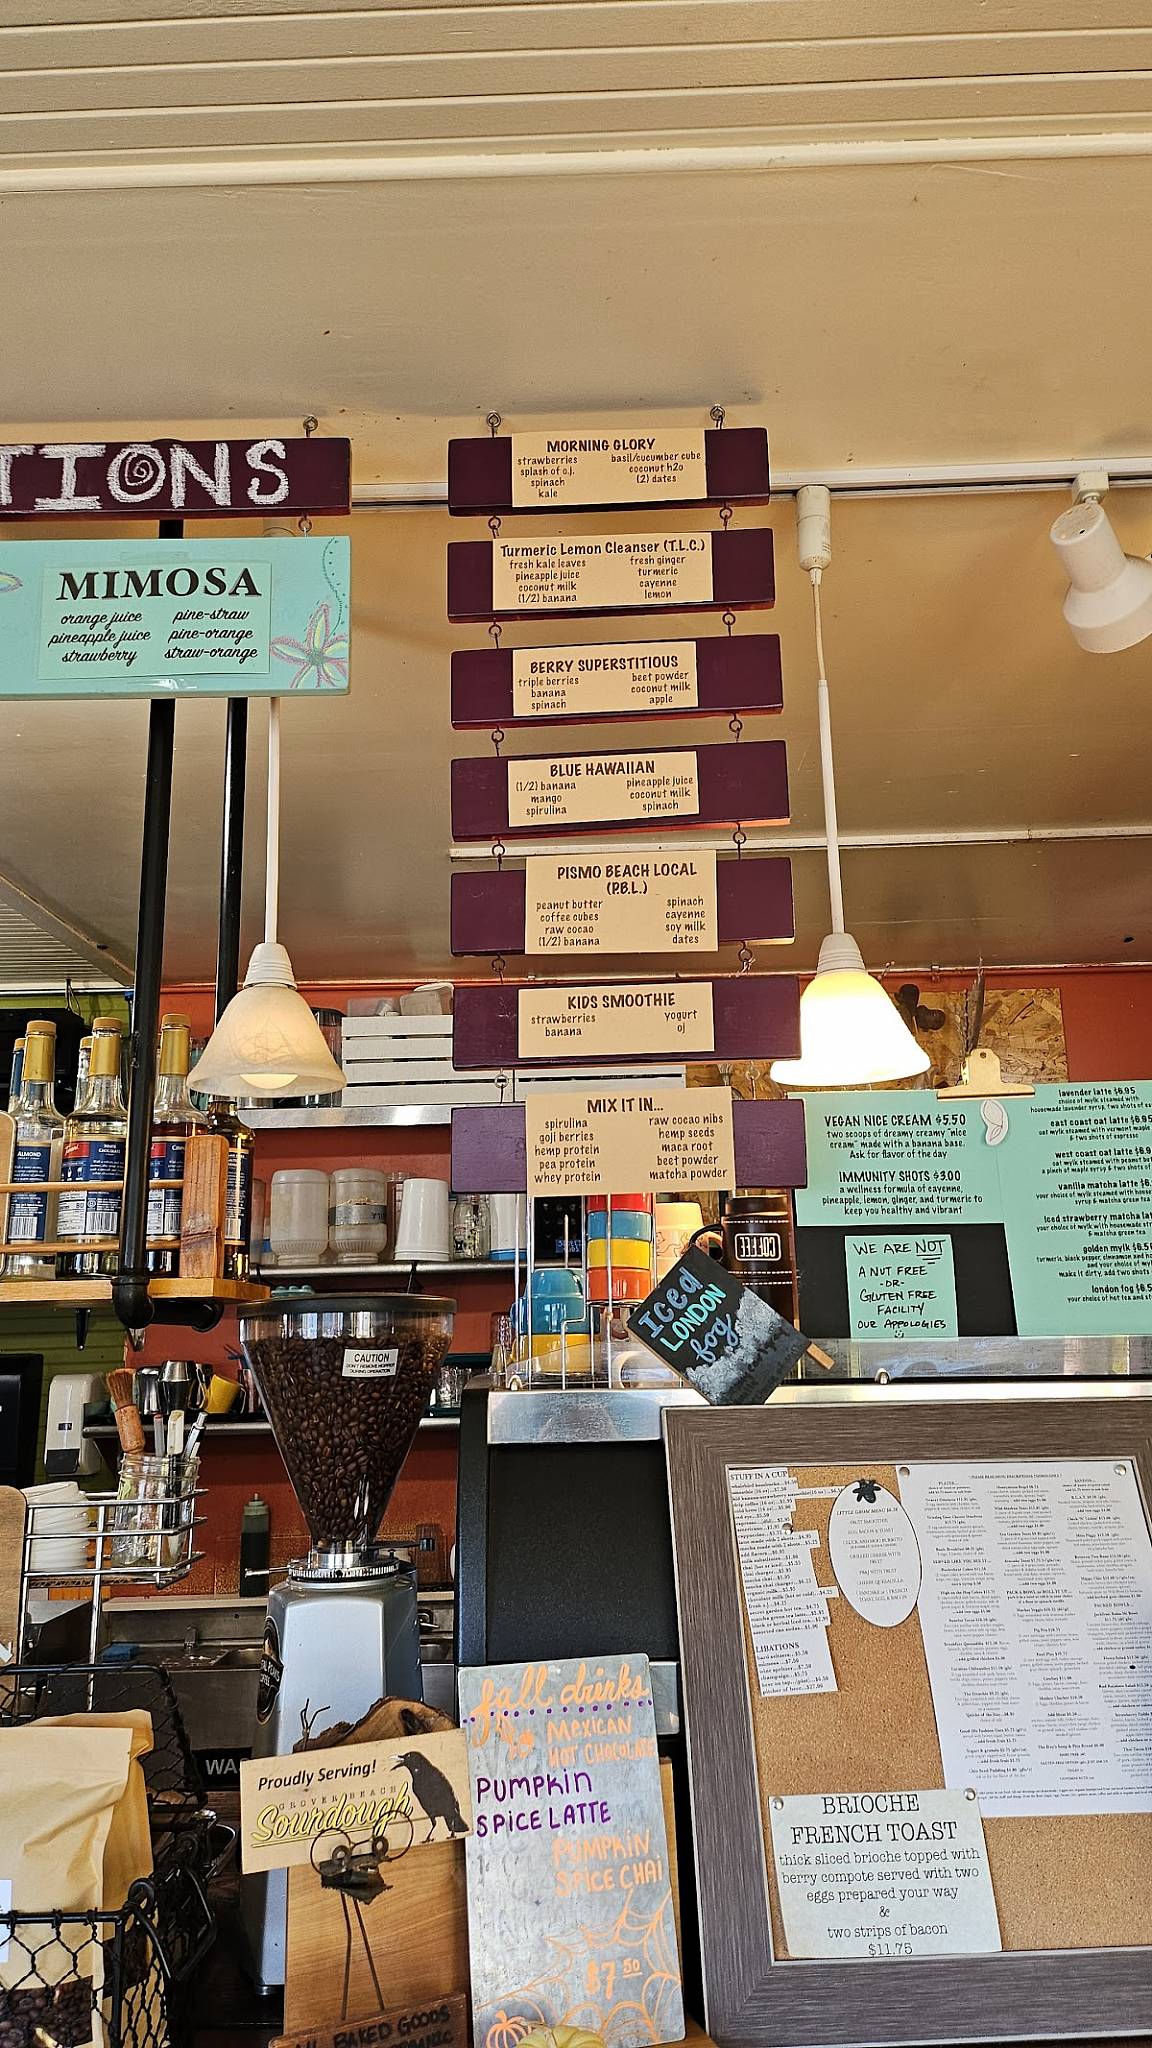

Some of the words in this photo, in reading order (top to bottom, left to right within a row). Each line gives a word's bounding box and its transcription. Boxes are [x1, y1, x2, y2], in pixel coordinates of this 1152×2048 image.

[547, 440, 609, 452] MORNING
[614, 439, 655, 450] GLORY
[518, 455, 577, 465] strawberries
[612, 452, 678, 462] basil/cucumber
[681, 451, 701, 460] cube
[521, 466, 548, 477] splash
[551, 466, 560, 475] of
[563, 466, 574, 476] o.j.
[629, 464, 664, 472] coconut
[667, 463, 683, 471] h2o
[531, 477, 564, 488] spinach
[637, 474, 649, 483] (2)
[539, 488, 557, 498] kale
[501, 545, 557, 557] Turmeric
[561, 543, 601, 555] Lemon
[605, 542, 659, 553] Cleanser
[664, 539, 704, 552] (T.L.C.)
[510, 559, 533, 569] fresh
[537, 559, 555, 568] kale
[558, 559, 585, 568] leaves
[630, 555, 654, 565] fresh
[657, 556, 686, 565] ginger
[56, 568, 262, 600] MIMOSA
[60, 611, 108, 624] orange
[105, 610, 143, 627] juice
[173, 608, 249, 624] pine-straw
[48, 630, 116, 645] pineapple
[112, 629, 151, 644] juice
[168, 629, 253, 645] pine-orange
[62, 648, 137, 667] strawberry
[164, 646, 257, 661] straw-orange
[531, 660, 573, 673] BERRY
[578, 656, 678, 671] SUPERSTITIOUS
[519, 677, 543, 688] triple
[547, 676, 578, 685] berries
[632, 673, 652, 681] beet
[655, 671, 688, 682] powder
[551, 764, 581, 777] BLUE
[586, 761, 654, 775] HAWAIIAN
[516, 781, 538, 791] (1/2)
[541, 781, 576, 790] banana
[627, 776, 670, 789] pineapple
[672, 776, 693, 787] juice
[558, 866, 601, 879] PISMO
[606, 864, 649, 878] BEACH
[654, 863, 697, 876] LOCAL
[537, 901, 569, 912] peanut
[572, 900, 603, 909] butter
[667, 896, 703, 908] spinach
[568, 996, 597, 1009] KIDS
[603, 993, 675, 1008] SMOOTHIE
[532, 1013, 595, 1024] strawberries
[665, 1010, 697, 1021] yogurt
[546, 1027, 582, 1036] banana
[678, 1023, 685, 1033] oj
[588, 1099, 617, 1113] MIX
[622, 1098, 634, 1112] IT
[639, 1098, 663, 1111] IN...
[649, 1117, 669, 1126] raw
[673, 1116, 699, 1125] cocao
[703, 1113, 723, 1124] nibs
[825, 1115, 860, 1127] VEGAN
[864, 1115, 887, 1126] NICE
[891, 1115, 931, 1125] CREAM
[936, 1114, 965, 1125] $5.50
[873, 1129, 881, 1137] of
[884, 1129, 913, 1138] dreamy
[916, 1130, 945, 1138] creamy
[850, 1150, 865, 1158] Ask
[867, 1149, 880, 1158] for
[882, 1150, 904, 1158] flavor
[907, 1149, 915, 1158] of
[918, 1149, 931, 1158] the
[933, 1150, 947, 1159] day
[839, 1171, 895, 1182] IMMUNITY
[899, 1171, 930, 1181] SHOTS
[933, 1171, 960, 1181] $3.00
[740, 1236, 776, 1258] COFFEE
[853, 1242, 877, 1255] WE
[884, 1243, 911, 1254] ARE
[916, 1239, 946, 1253] NOT
[859, 1266, 866, 1277] A
[870, 1267, 892, 1276] NUT
[897, 1266, 927, 1275] FREE
[638, 1266, 704, 1338] Iced
[860, 1289, 904, 1302] GLUTEN
[908, 1291, 937, 1299] FREE
[878, 1302, 924, 1315] FACILITY
[660, 1283, 727, 1352] LONDON
[690, 1313, 739, 1363] fog
[354, 1353, 389, 1362] CAUTION
[474, 1668, 553, 1748] fall
[559, 1664, 650, 1705] drinks
[206, 1758, 248, 1775] WA
[258, 1770, 315, 1791] Proudly
[318, 1759, 378, 1781] Serving!
[278, 1794, 339, 1811] GROVER
[349, 1785, 397, 1799] BEACH
[821, 1794, 919, 1814] BRIOCHE
[253, 1782, 414, 1840] Sourdough
[791, 1824, 882, 1844] FRENCH
[887, 1822, 957, 1841] TOAST
[780, 1854, 811, 1865] thick
[815, 1852, 850, 1865] sliced
[854, 1851, 901, 1863] brioche
[904, 1849, 948, 1864] topped
[951, 1848, 980, 1859] with
[828, 1927, 851, 1938] two
[854, 1926, 891, 1939] strips
[895, 1924, 907, 1936] of
[909, 1924, 947, 1935] bacon
[866, 1943, 915, 1958] $11.75
